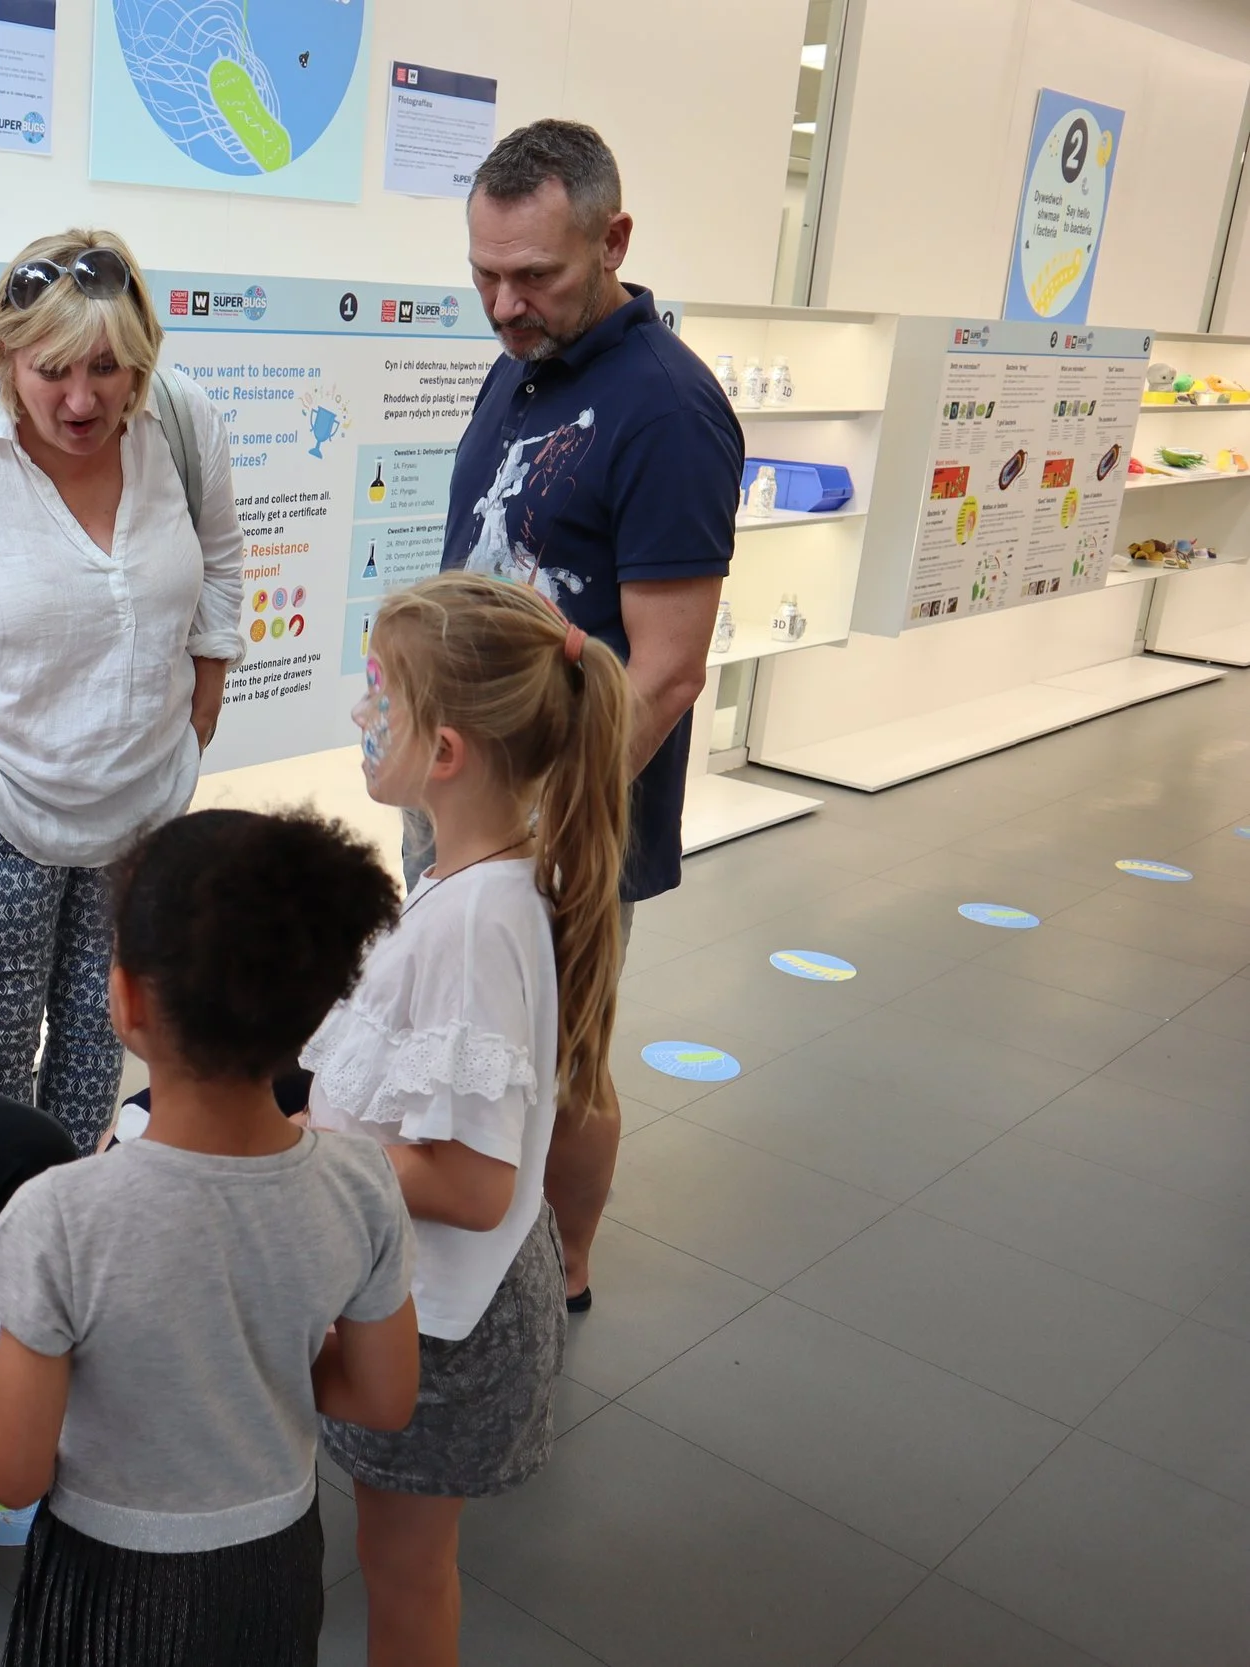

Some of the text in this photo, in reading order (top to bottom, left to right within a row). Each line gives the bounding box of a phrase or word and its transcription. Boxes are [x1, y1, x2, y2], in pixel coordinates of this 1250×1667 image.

[1066, 129, 1084, 169] 2
[195, 295, 207, 308] W
[344, 297, 354, 315] 1
[401, 304, 411, 316] W
[192, 364, 321, 380] you want to become an
[385, 360, 398, 371] Cyn
[403, 361, 414, 369] chi
[450, 361, 476, 372] helpwch
[477, 362, 484, 370] ni
[419, 376, 456, 387] cwestiynau
[233, 386, 295, 400] Resistance
[383, 393, 419, 403] Rhoddwch
[432, 394, 455, 404] plastig
[384, 408, 459, 420] gwpan rydych yn credu
[242, 430, 298, 445] some cool
[235, 491, 331, 506] card and collect them all.
[267, 506, 327, 522] get a certificate
[274, 527, 283, 535] an
[251, 542, 310, 558] Resistance
[772, 619, 786, 630] 3D
[239, 653, 321, 674] questionnaire and you
[232, 677, 247, 689] into
[249, 675, 262, 686] the
[263, 673, 281, 687] prize
[283, 668, 312, 682] drawers
[222, 681, 311, 705] to win a bag of goodies!
